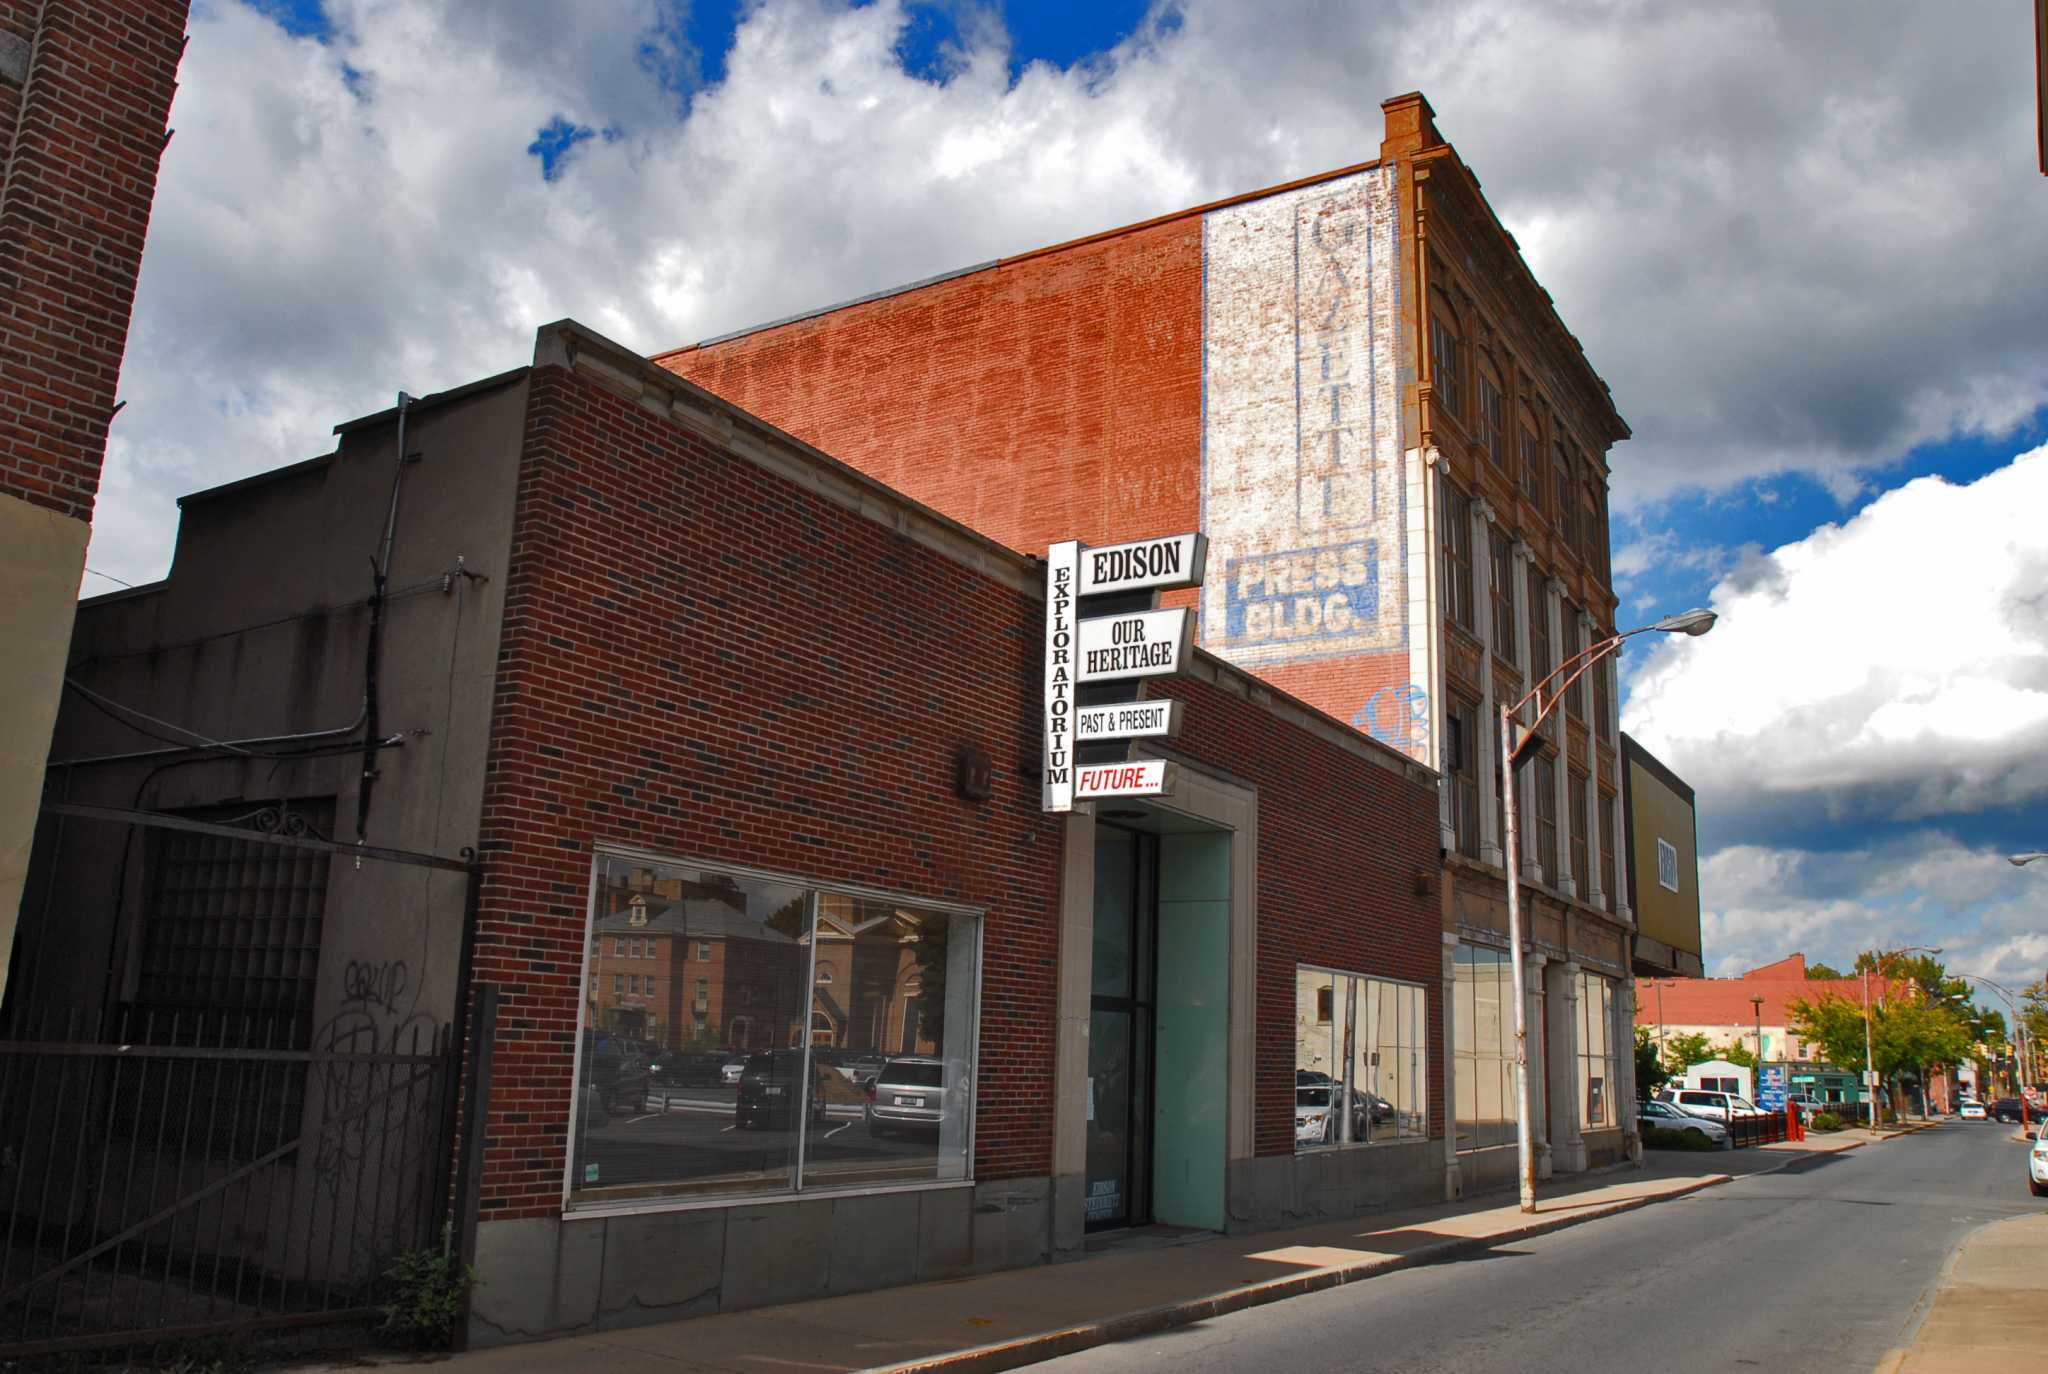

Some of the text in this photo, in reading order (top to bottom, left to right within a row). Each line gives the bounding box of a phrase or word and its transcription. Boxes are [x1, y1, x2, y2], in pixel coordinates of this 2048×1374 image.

[1092, 540, 1181, 585] EDISON
[1111, 618, 1146, 646] OUR
[1086, 640, 1173, 675] HERITAGE
[1046, 566, 1071, 785] EXPLORATORIUM
[1080, 707, 1165, 734] PAST & PRESENT
[1079, 766, 1159, 792] FUTURE...
